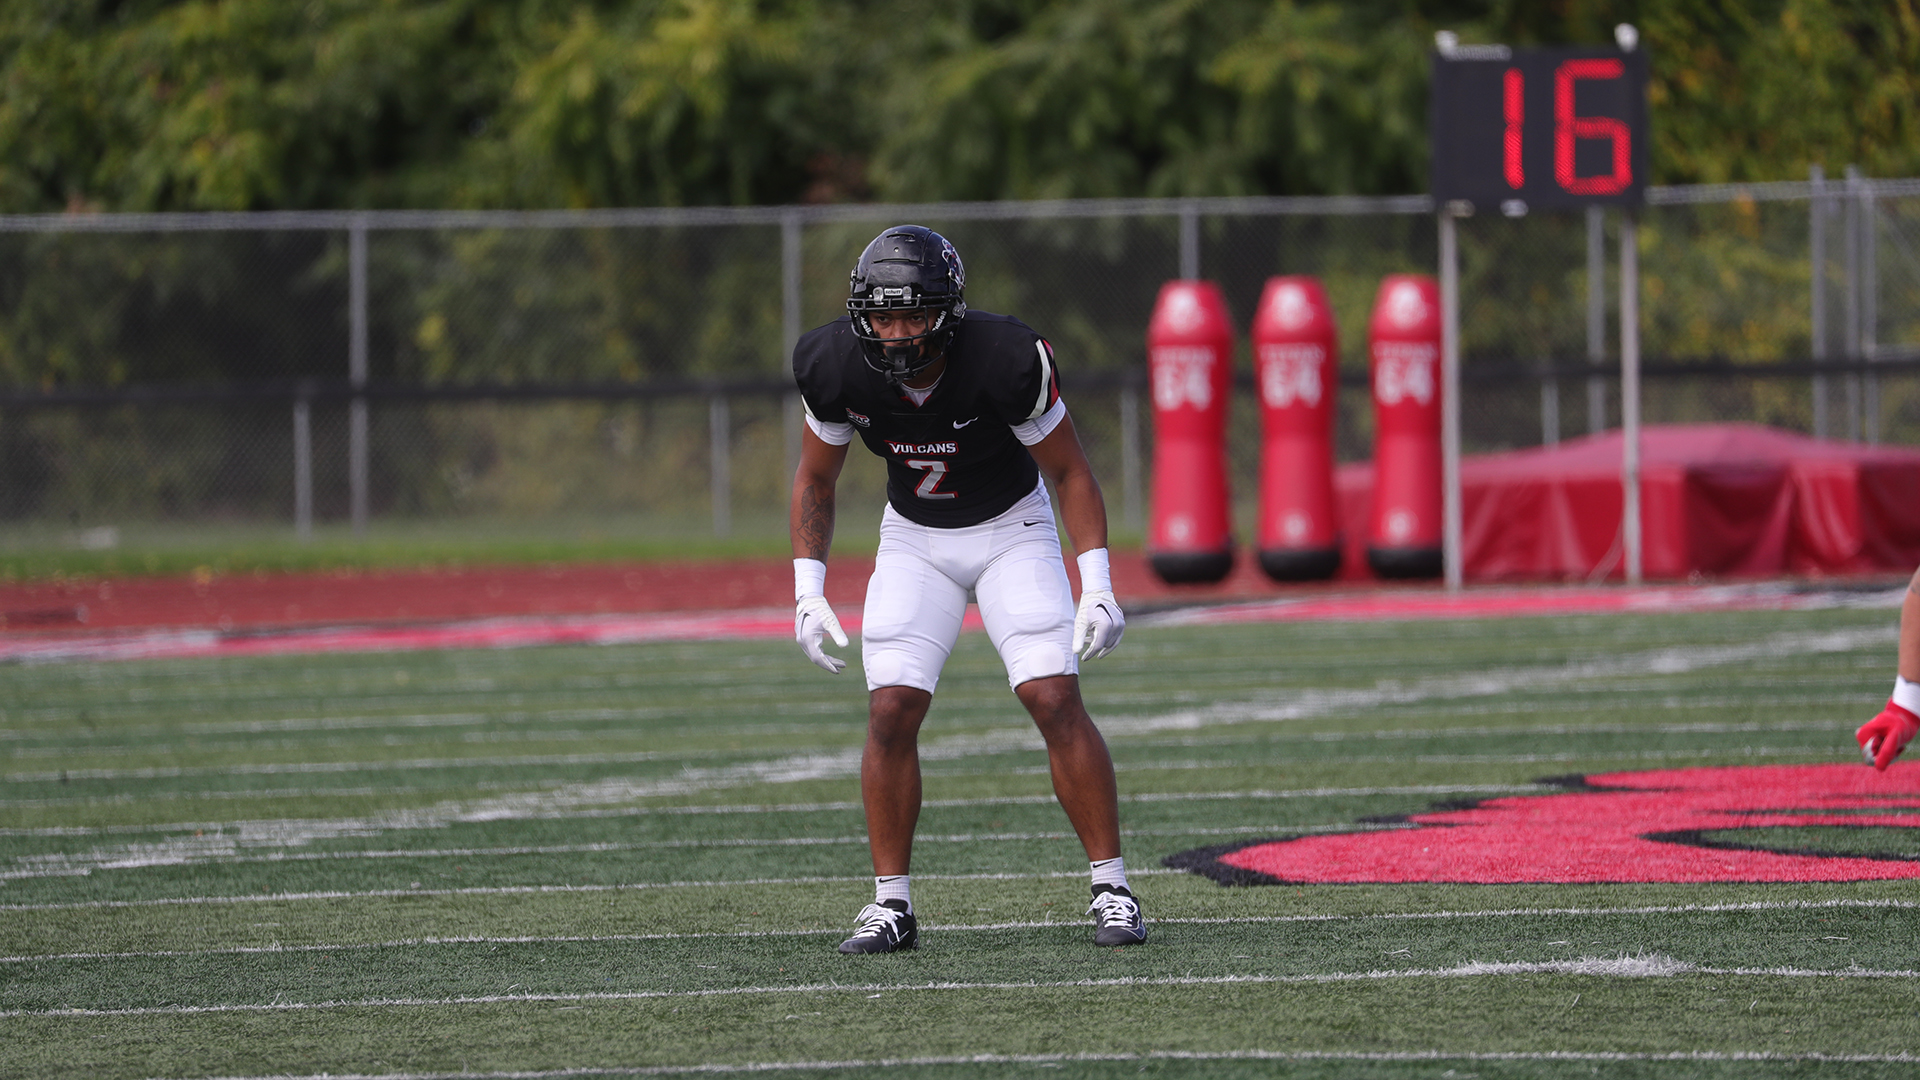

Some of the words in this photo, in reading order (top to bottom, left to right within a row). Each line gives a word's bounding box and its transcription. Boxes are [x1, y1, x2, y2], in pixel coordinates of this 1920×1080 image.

[1503, 58, 1633, 195] 16
[886, 441, 958, 454] VULCANS
[904, 459, 958, 499] 2
